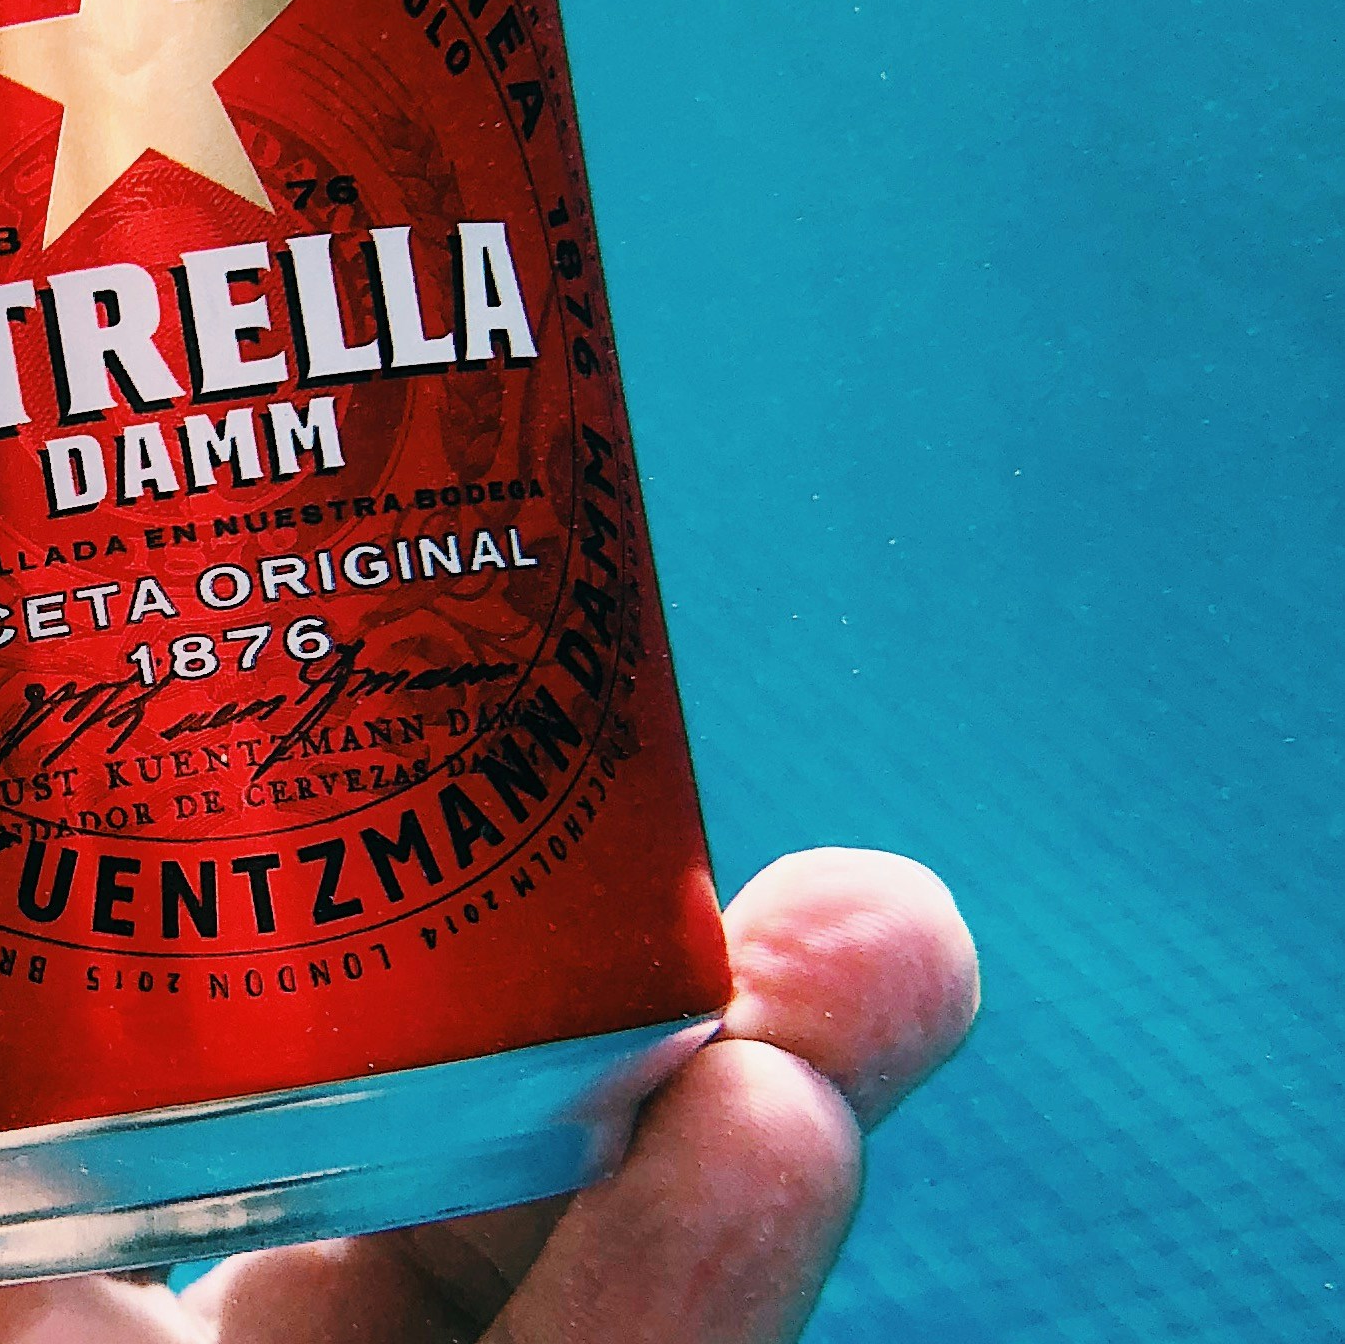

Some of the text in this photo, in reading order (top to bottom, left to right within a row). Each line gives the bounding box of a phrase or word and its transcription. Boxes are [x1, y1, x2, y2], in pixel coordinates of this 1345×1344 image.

[286, 174, 358, 212] 76
[548, 196, 601, 380] 1876
[44, 395, 345, 517] DAMM
[144, 522, 197, 549] EN
[214, 493, 404, 536] NUESTRA
[415, 478, 545, 509] BODEGA
[197, 527, 539, 609] ORIGINAL
[555, 424, 617, 701] DAMM
[129, 616, 334, 687] 1876
[173, 791, 224, 820] DE
[244, 758, 428, 807] CERVEZAS
[420, 890, 499, 950] 2014
[85, 943, 392, 1000] LONDON 2015
